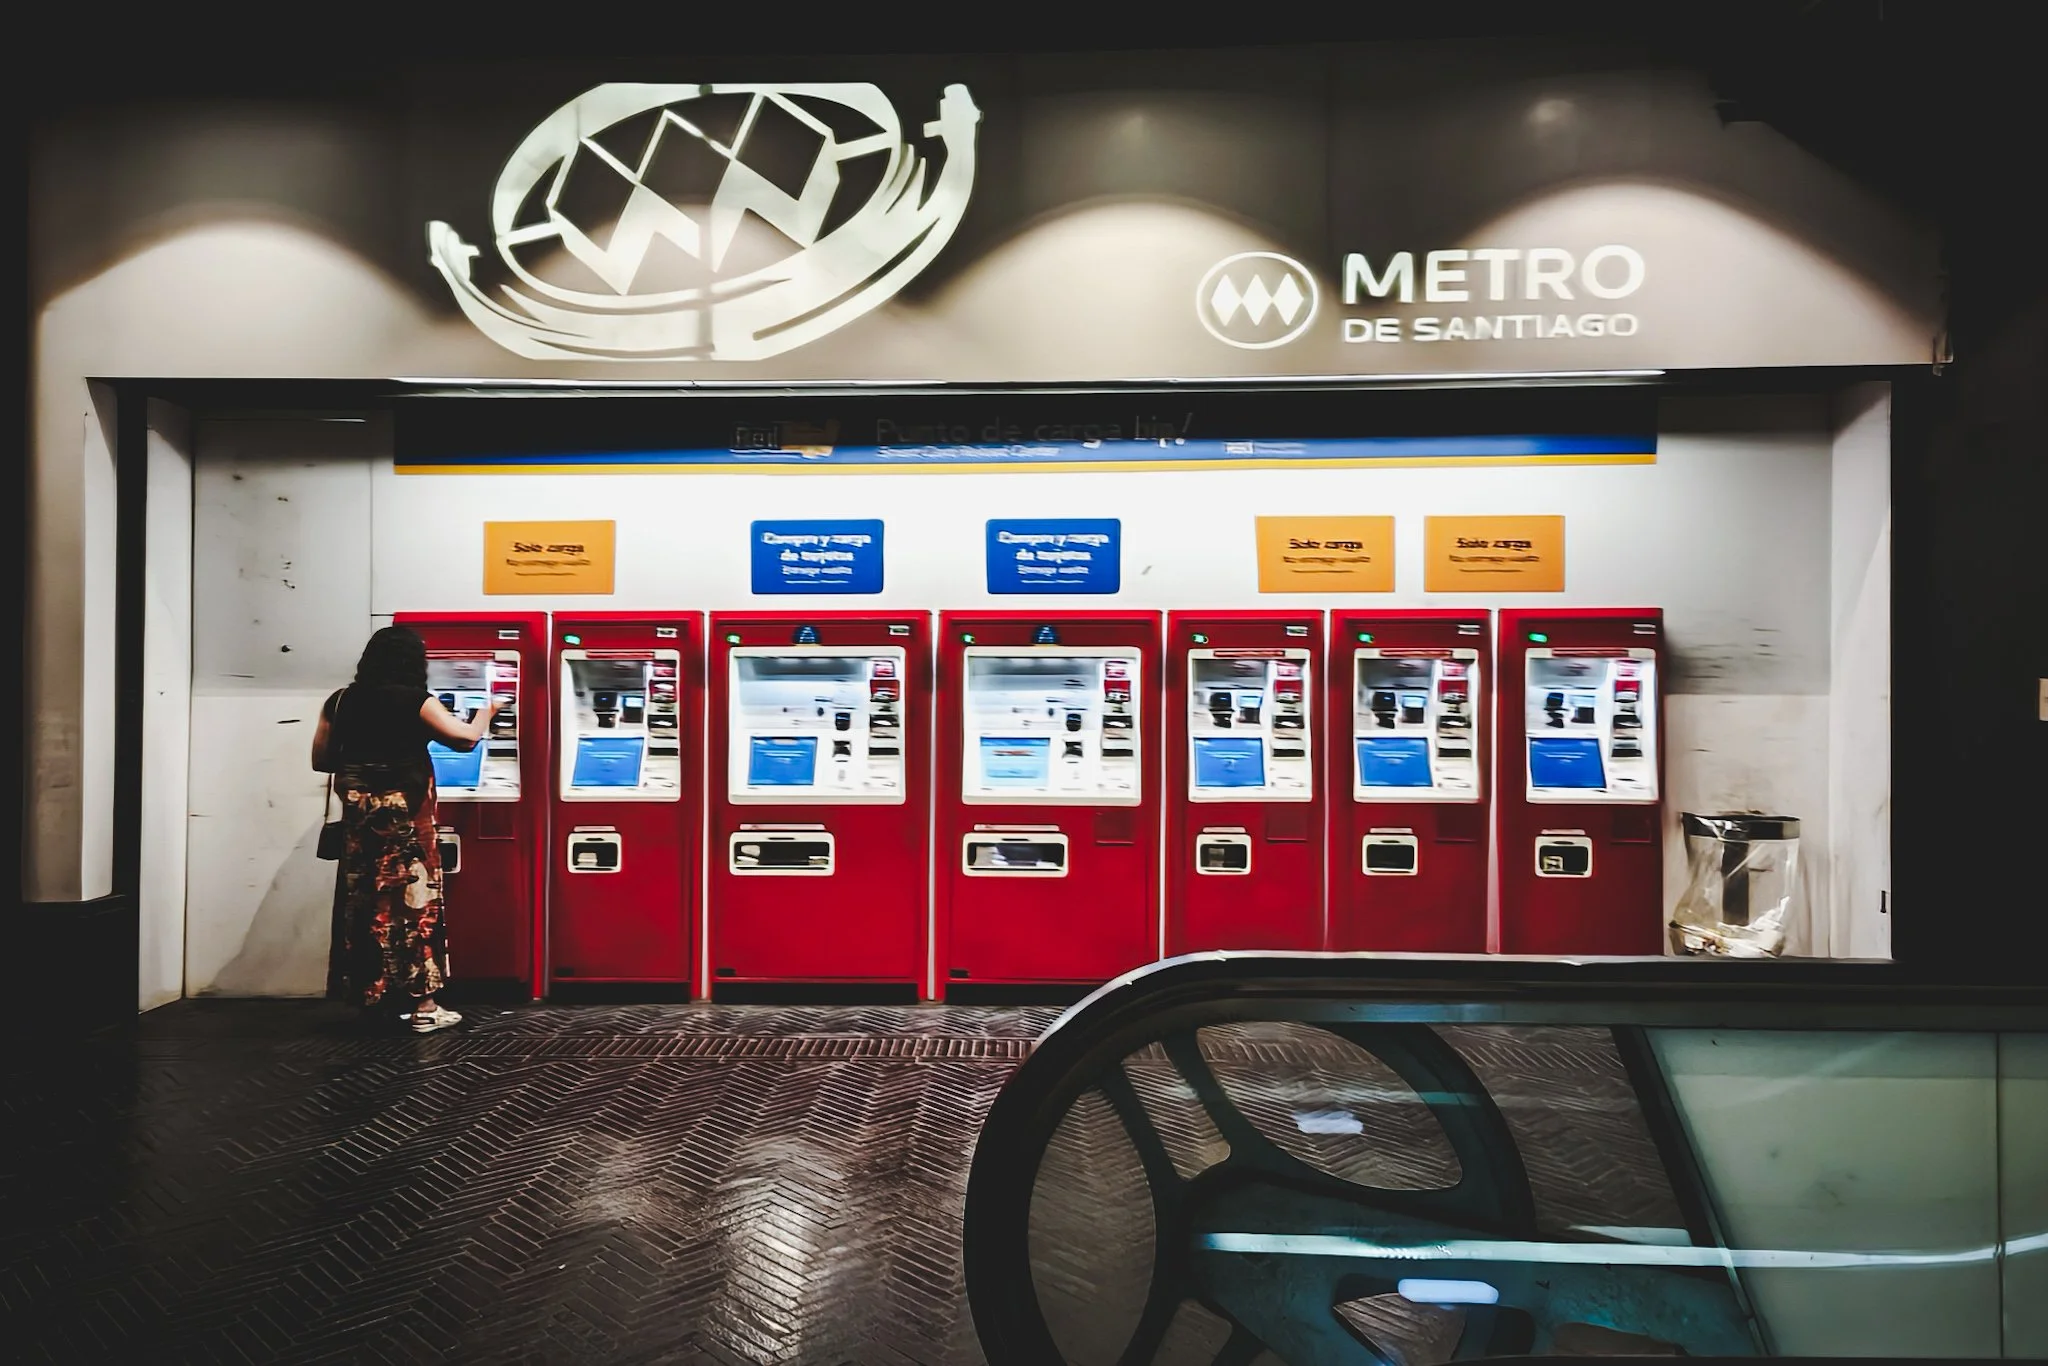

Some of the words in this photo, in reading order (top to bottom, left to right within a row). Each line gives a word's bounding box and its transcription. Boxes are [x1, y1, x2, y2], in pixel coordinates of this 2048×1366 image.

[1343, 245, 1646, 304] METRO
[1344, 318, 1400, 343] DE
[1413, 313, 1639, 341] SANTIAGO
[876, 417, 971, 443] Punto
[981, 417, 1022, 442] de
[1033, 422, 1122, 449] carga
